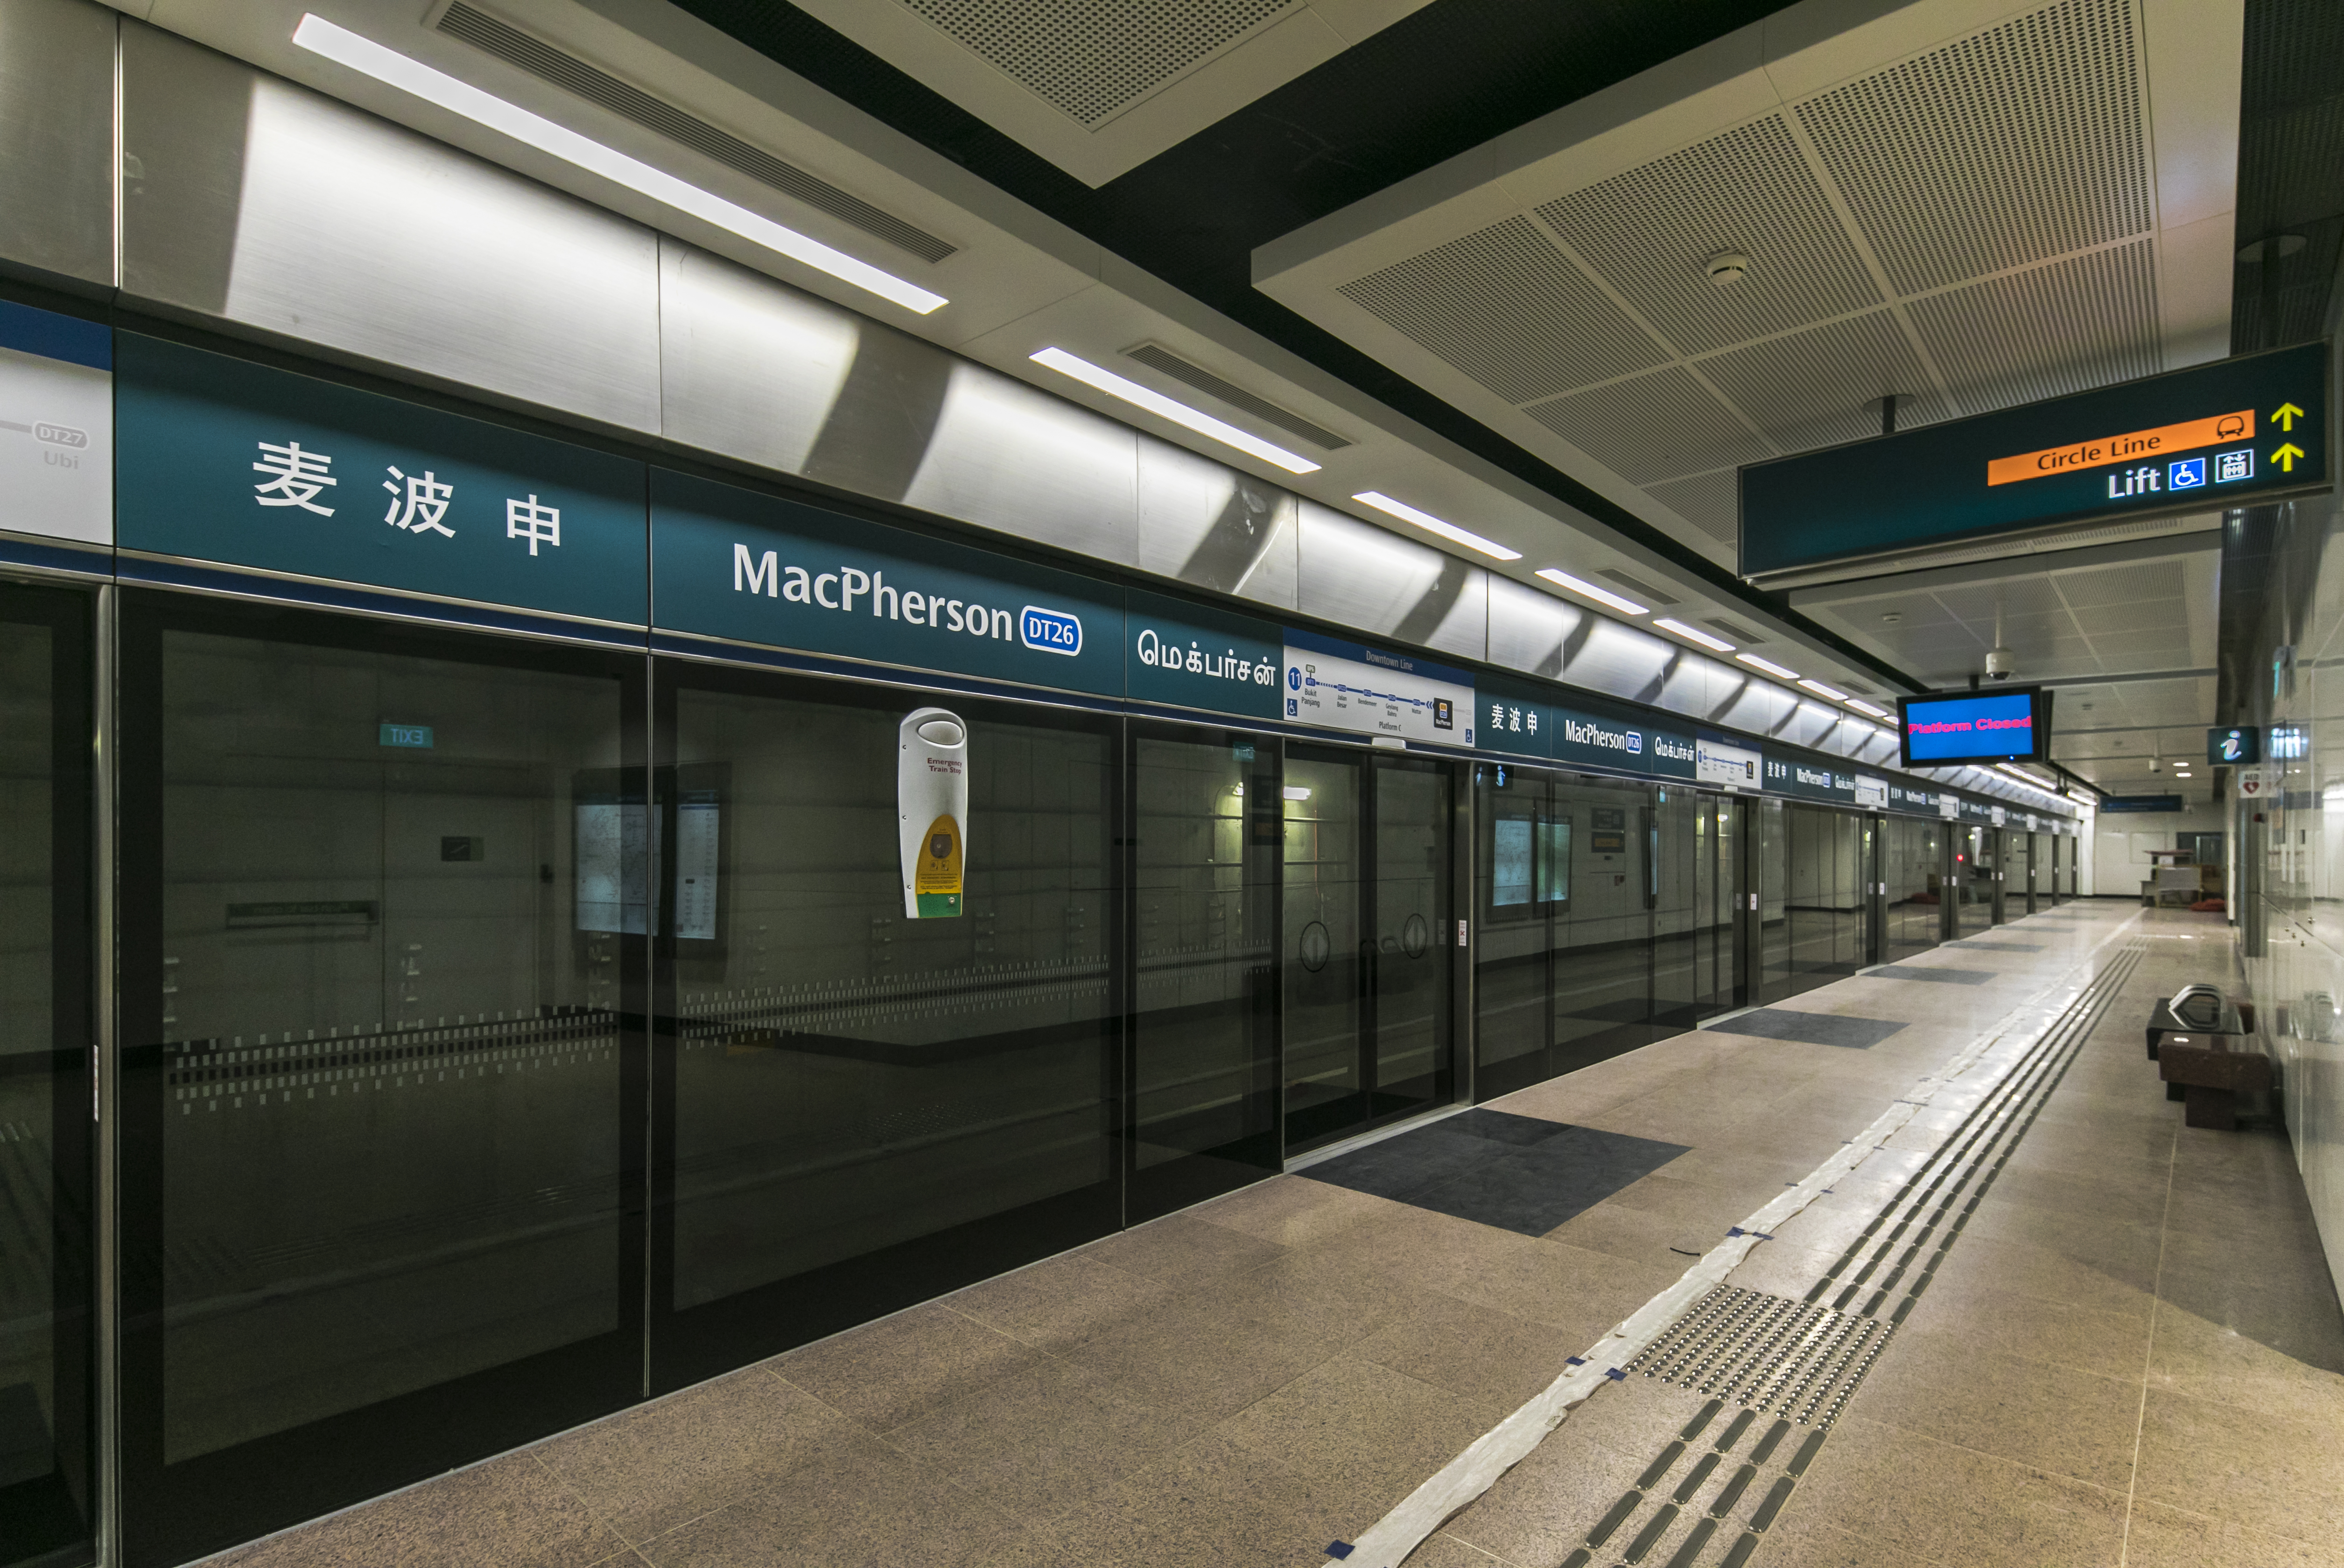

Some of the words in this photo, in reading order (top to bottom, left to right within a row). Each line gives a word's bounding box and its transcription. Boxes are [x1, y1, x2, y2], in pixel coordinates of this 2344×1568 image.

[39, 426, 83, 444] DT27
[44, 451, 78, 469] Ubi
[2037, 446, 2101, 470] Circle
[2111, 434, 2161, 457] Line
[2108, 467, 2161, 499] Lift
[253, 441, 560, 556] 麦波申
[734, 543, 1012, 641] MacPherson
[1029, 617, 1074, 645] DT26
[1366, 650, 1398, 667] Downtown
[1400, 659, 1413, 671] Line
[1290, 672, 1300, 686] 11
[1305, 688, 1317, 697] Bukit
[1301, 697, 1320, 708] Panjang
[1358, 698, 1377, 707] Bendemeer
[1386, 703, 1398, 712] Geylang
[1379, 721, 1397, 731] Platform
[1491, 703, 1537, 735] 麦波申
[1909, 721, 1972, 735] Platform
[1975, 715, 2032, 731] Closed
[1566, 720, 1625, 750] MacPherson
[1628, 736, 1640, 749] DT26
[927, 757, 962, 768] Emergency
[950, 767, 961, 775] Stop
